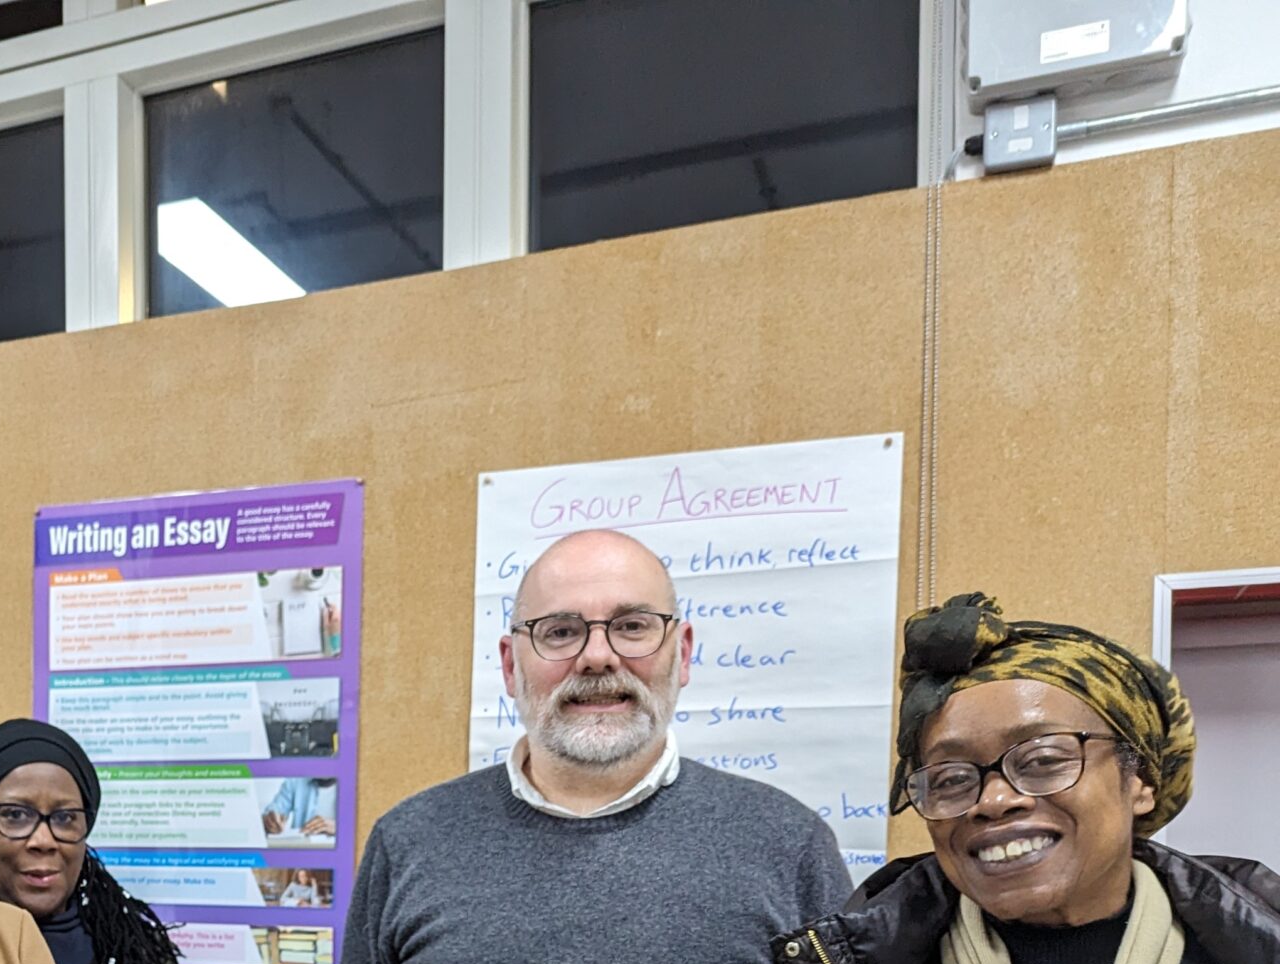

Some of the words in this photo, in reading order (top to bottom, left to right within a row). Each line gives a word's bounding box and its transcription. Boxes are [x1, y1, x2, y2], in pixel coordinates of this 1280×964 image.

[531, 478, 642, 529] GROUP
[657, 466, 842, 519] AGREEMENT
[49, 521, 127, 557] Writing
[131, 523, 159, 549] an
[163, 515, 231, 550] Essay
[690, 541, 776, 572] think,
[788, 538, 861, 568] reflect
[54, 574, 79, 583] Make
[87, 572, 108, 581] Plan
[717, 644, 796, 668] clear
[54, 677, 105, 687] Introduction
[707, 696, 786, 725] share
[841, 792, 888, 819] back
